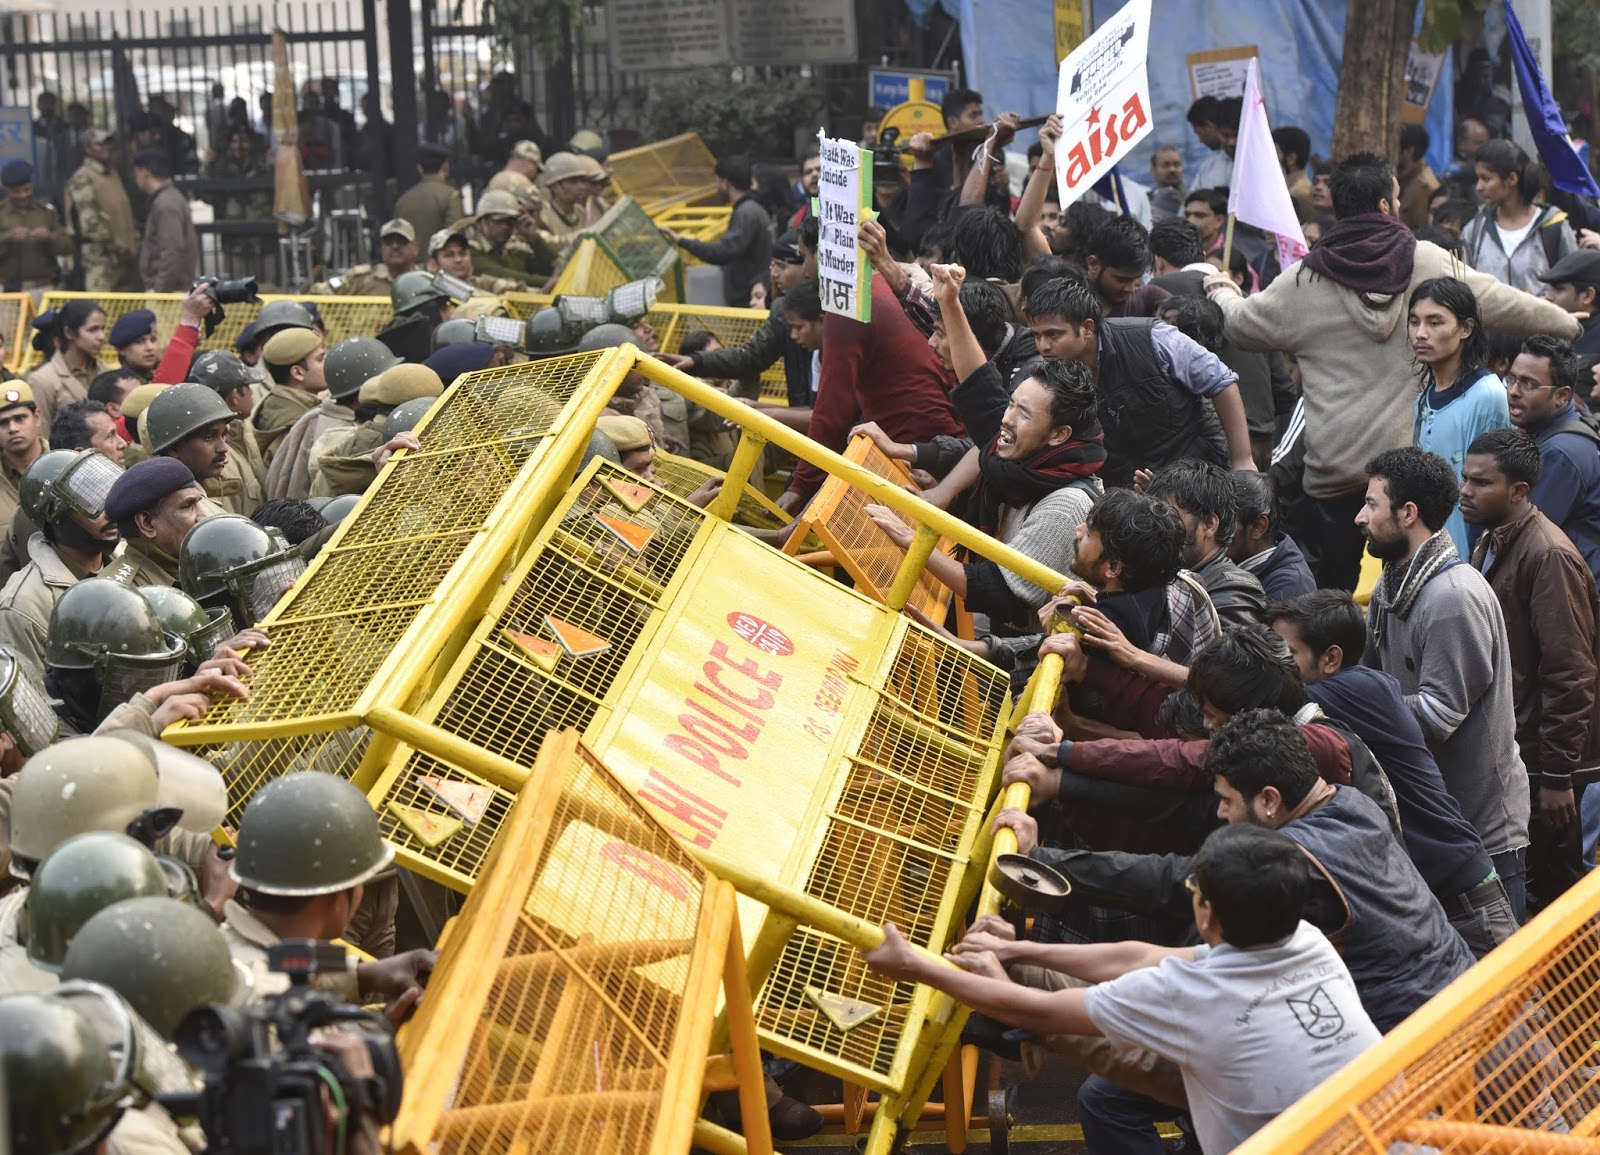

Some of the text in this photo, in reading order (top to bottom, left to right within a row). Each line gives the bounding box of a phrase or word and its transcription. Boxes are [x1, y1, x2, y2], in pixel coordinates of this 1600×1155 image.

[1066, 92, 1147, 188] aisa
[840, 148, 855, 168] Was
[825, 201, 854, 225] It Was
[835, 228, 854, 249] Plain
[825, 248, 854, 274] Murder
[662, 639, 784, 788] POLICE
